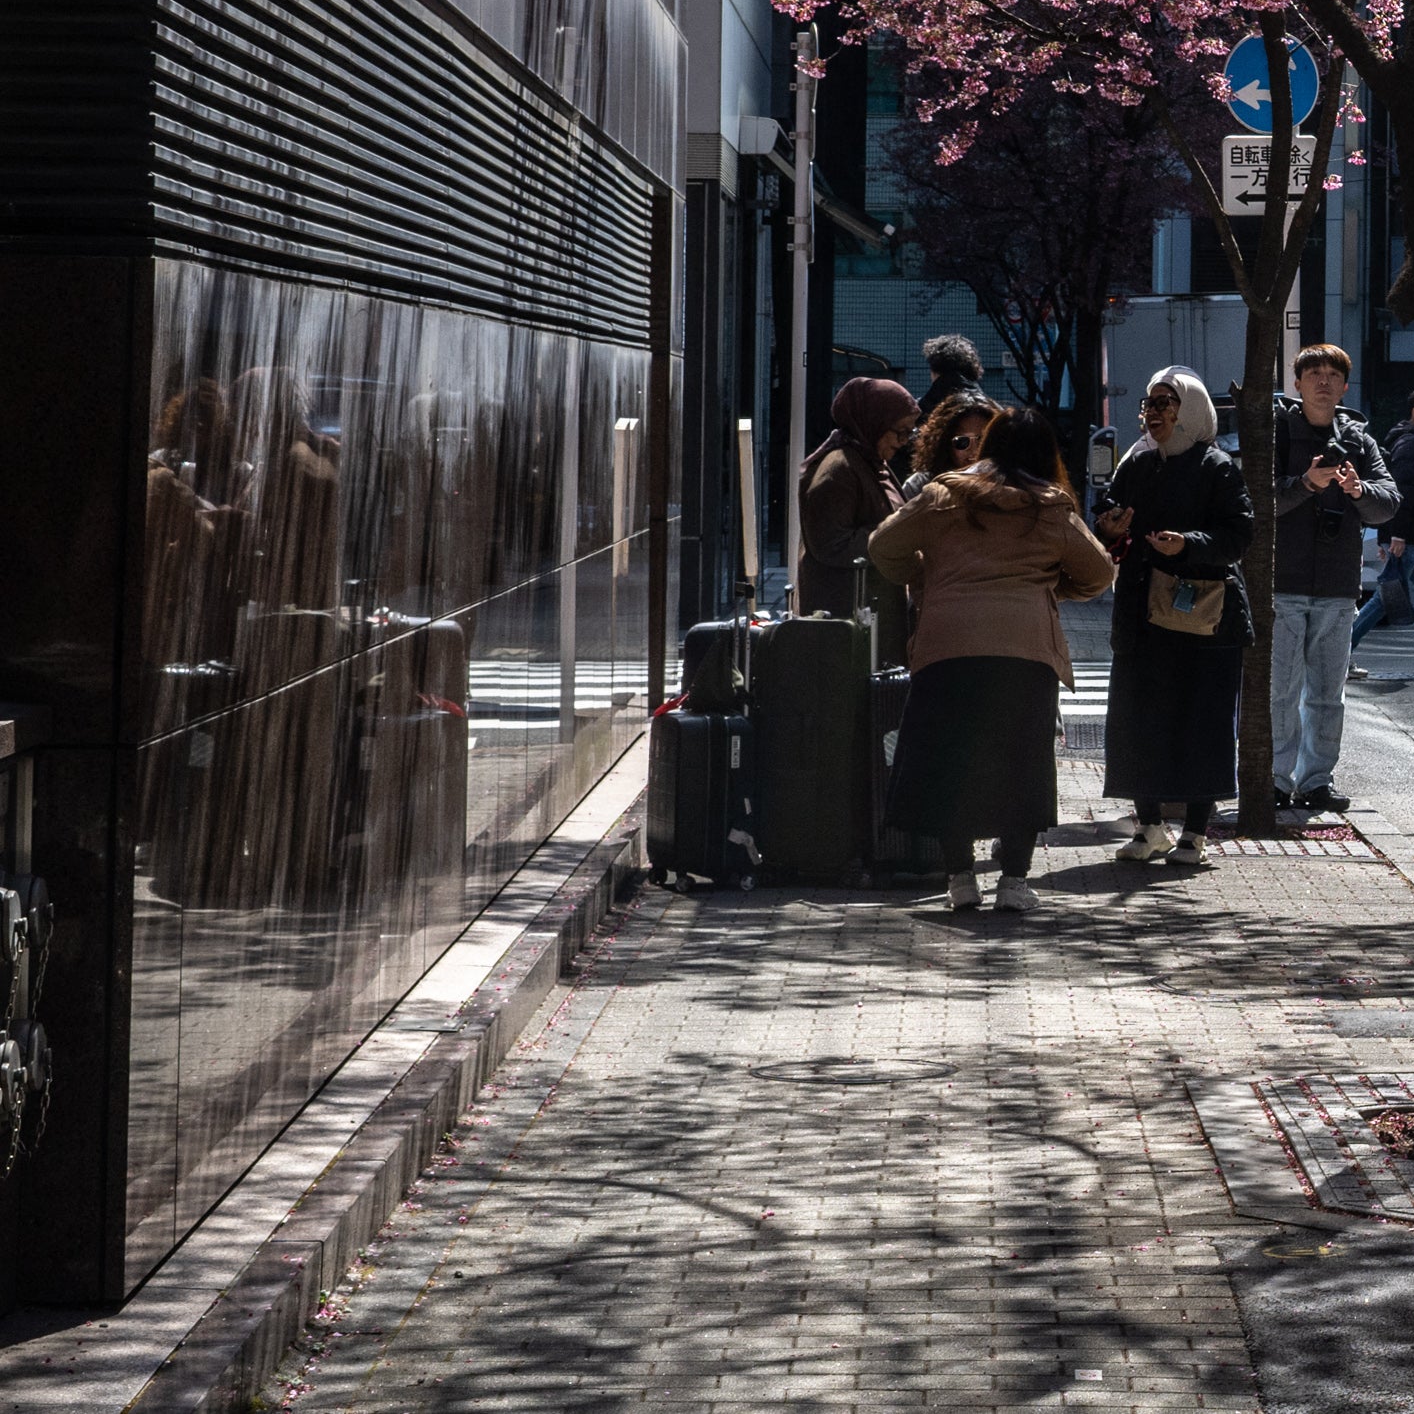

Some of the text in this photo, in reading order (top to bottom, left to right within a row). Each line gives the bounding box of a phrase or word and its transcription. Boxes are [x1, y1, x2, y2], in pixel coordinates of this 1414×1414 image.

[1230, 144, 1310, 164] 自転車除く
[1230, 167, 1312, 187] 一方行
